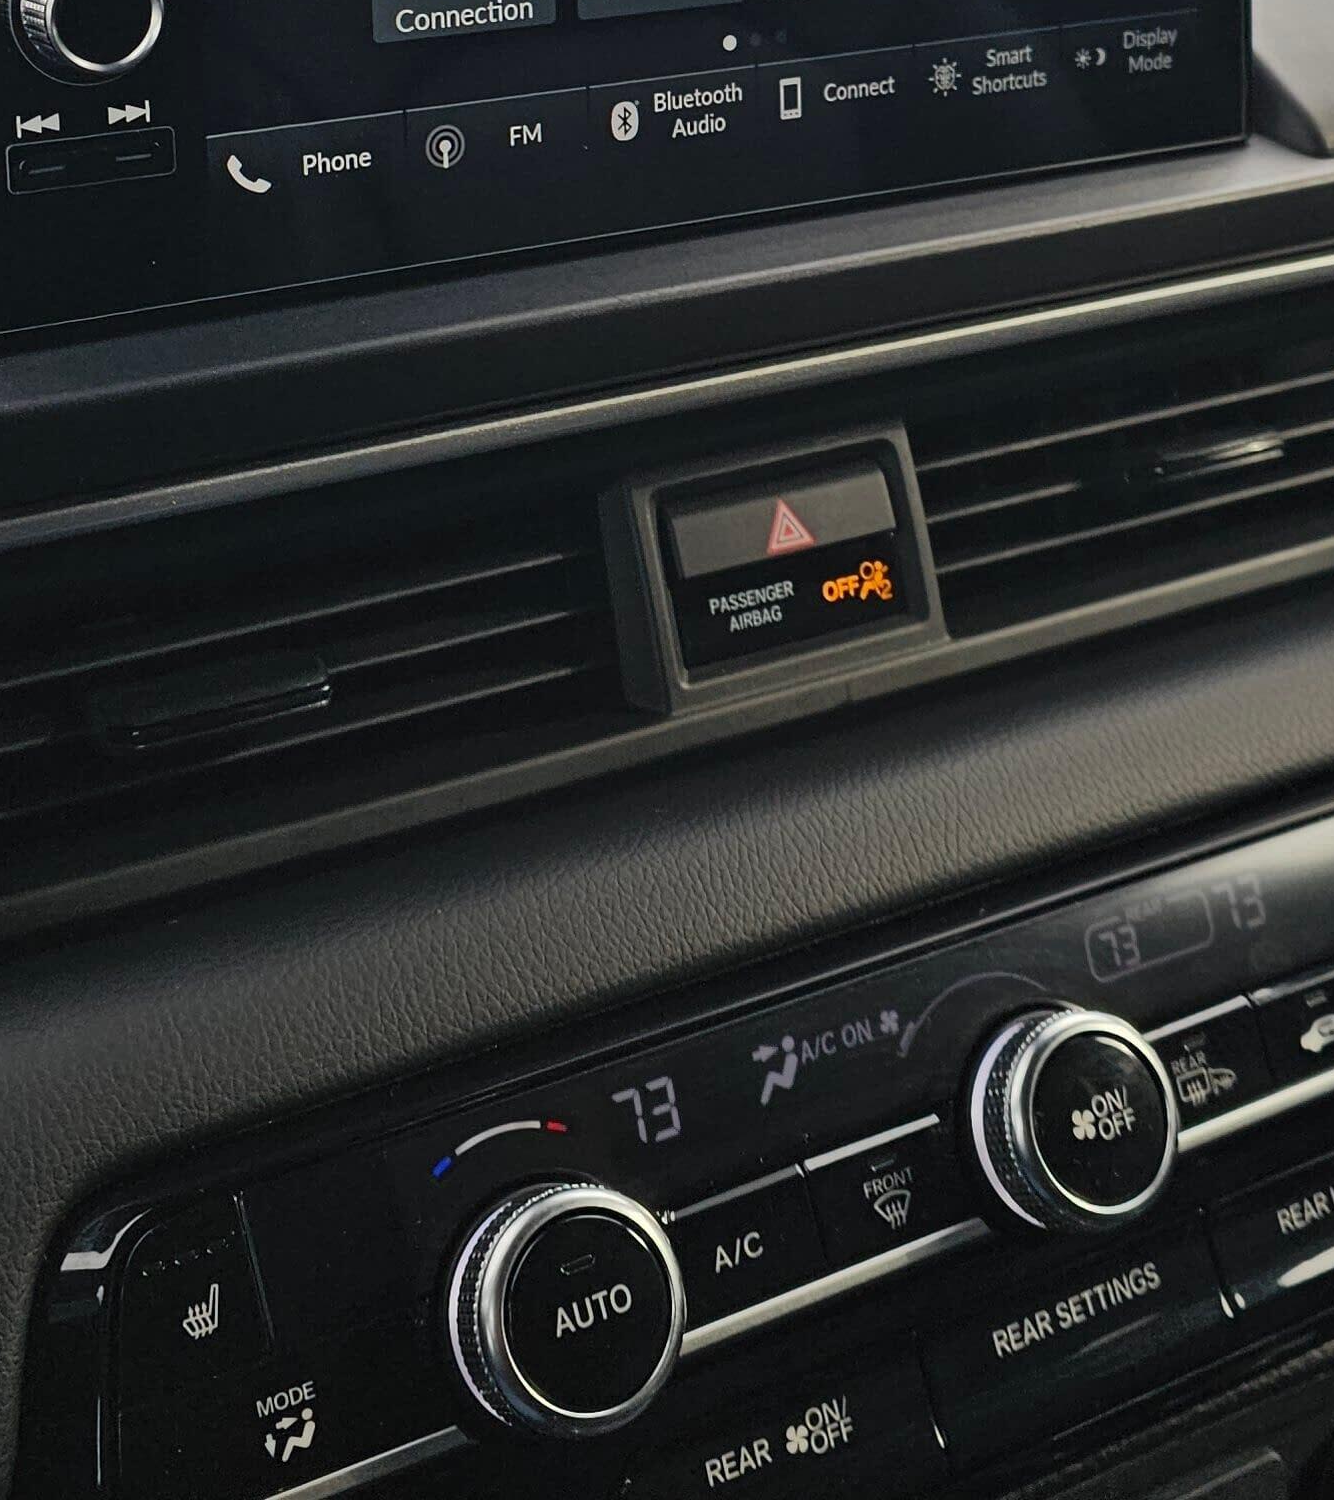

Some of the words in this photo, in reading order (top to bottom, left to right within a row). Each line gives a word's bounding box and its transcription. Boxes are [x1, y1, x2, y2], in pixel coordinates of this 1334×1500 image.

[1122, 26, 1178, 50] Display
[986, 45, 1033, 68] Smart
[1128, 52, 1173, 73] Mode
[653, 82, 743, 113] Bluetooth
[823, 75, 895, 102] Connect
[972, 69, 1048, 96] Shortcuts
[509, 122, 542, 147] FM
[671, 113, 727, 139] Audio
[302, 151, 372, 176] Phone
[708, 580, 795, 615] PASSENGER
[823, 575, 860, 602] OFF
[728, 605, 783, 632] AIRBAG
[1210, 872, 1267, 929] 73
[1099, 923, 1141, 967] 73
[801, 1030, 837, 1066] A/C
[841, 1018, 875, 1048] ON
[1170, 1049, 1208, 1077] REAR
[612, 1076, 682, 1143] 73
[1091, 1088, 1127, 1119] ON/
[1098, 1111, 1135, 1141] OFF
[863, 1166, 913, 1198] FRONT
[1276, 1191, 1334, 1235] REAR
[715, 1231, 764, 1274] A/C
[556, 1283, 632, 1338] AUTO
[992, 1310, 1054, 1359] REAR
[1057, 1260, 1161, 1331] SETTINGS
[255, 1380, 317, 1417] MODE
[703, 1438, 774, 1488] REAR
[803, 1395, 848, 1435] ON/
[809, 1418, 853, 1455] OFF
